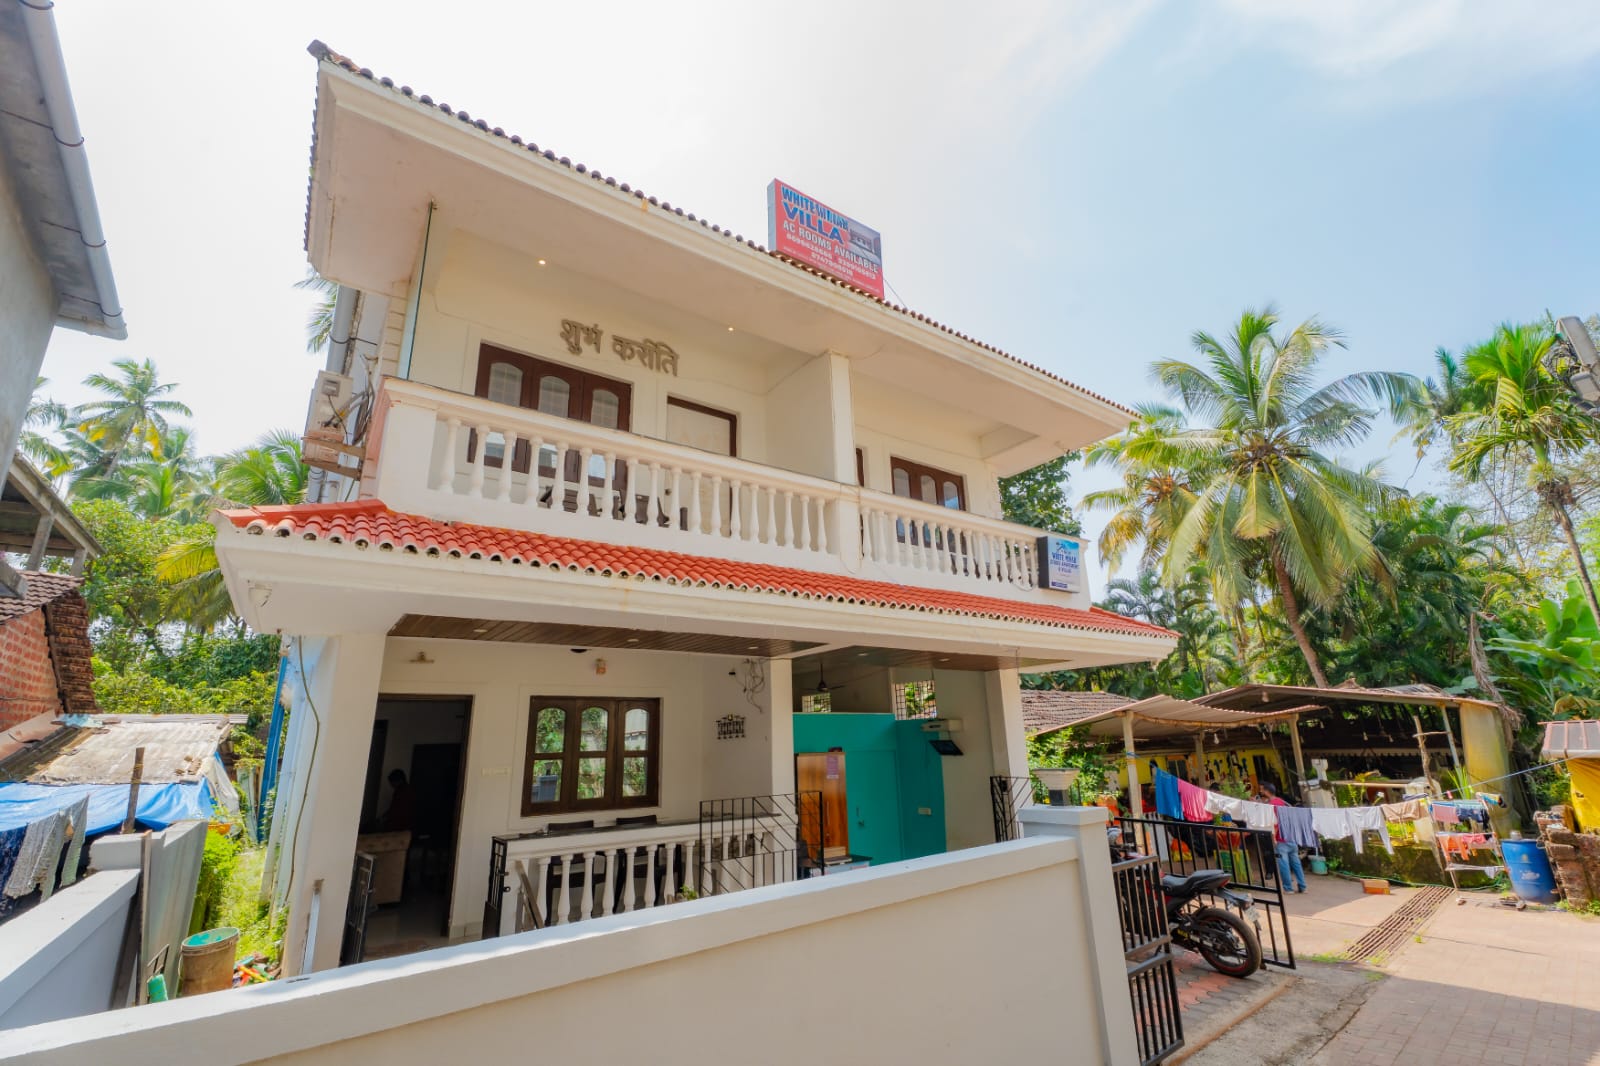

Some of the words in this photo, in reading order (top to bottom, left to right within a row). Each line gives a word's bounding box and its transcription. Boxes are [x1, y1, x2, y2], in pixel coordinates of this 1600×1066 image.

[782, 200, 844, 245] VILLA
[783, 220, 796, 233] AC
[798, 226, 832, 250] ROOMS
[834, 245, 878, 273] AVAILABLE
